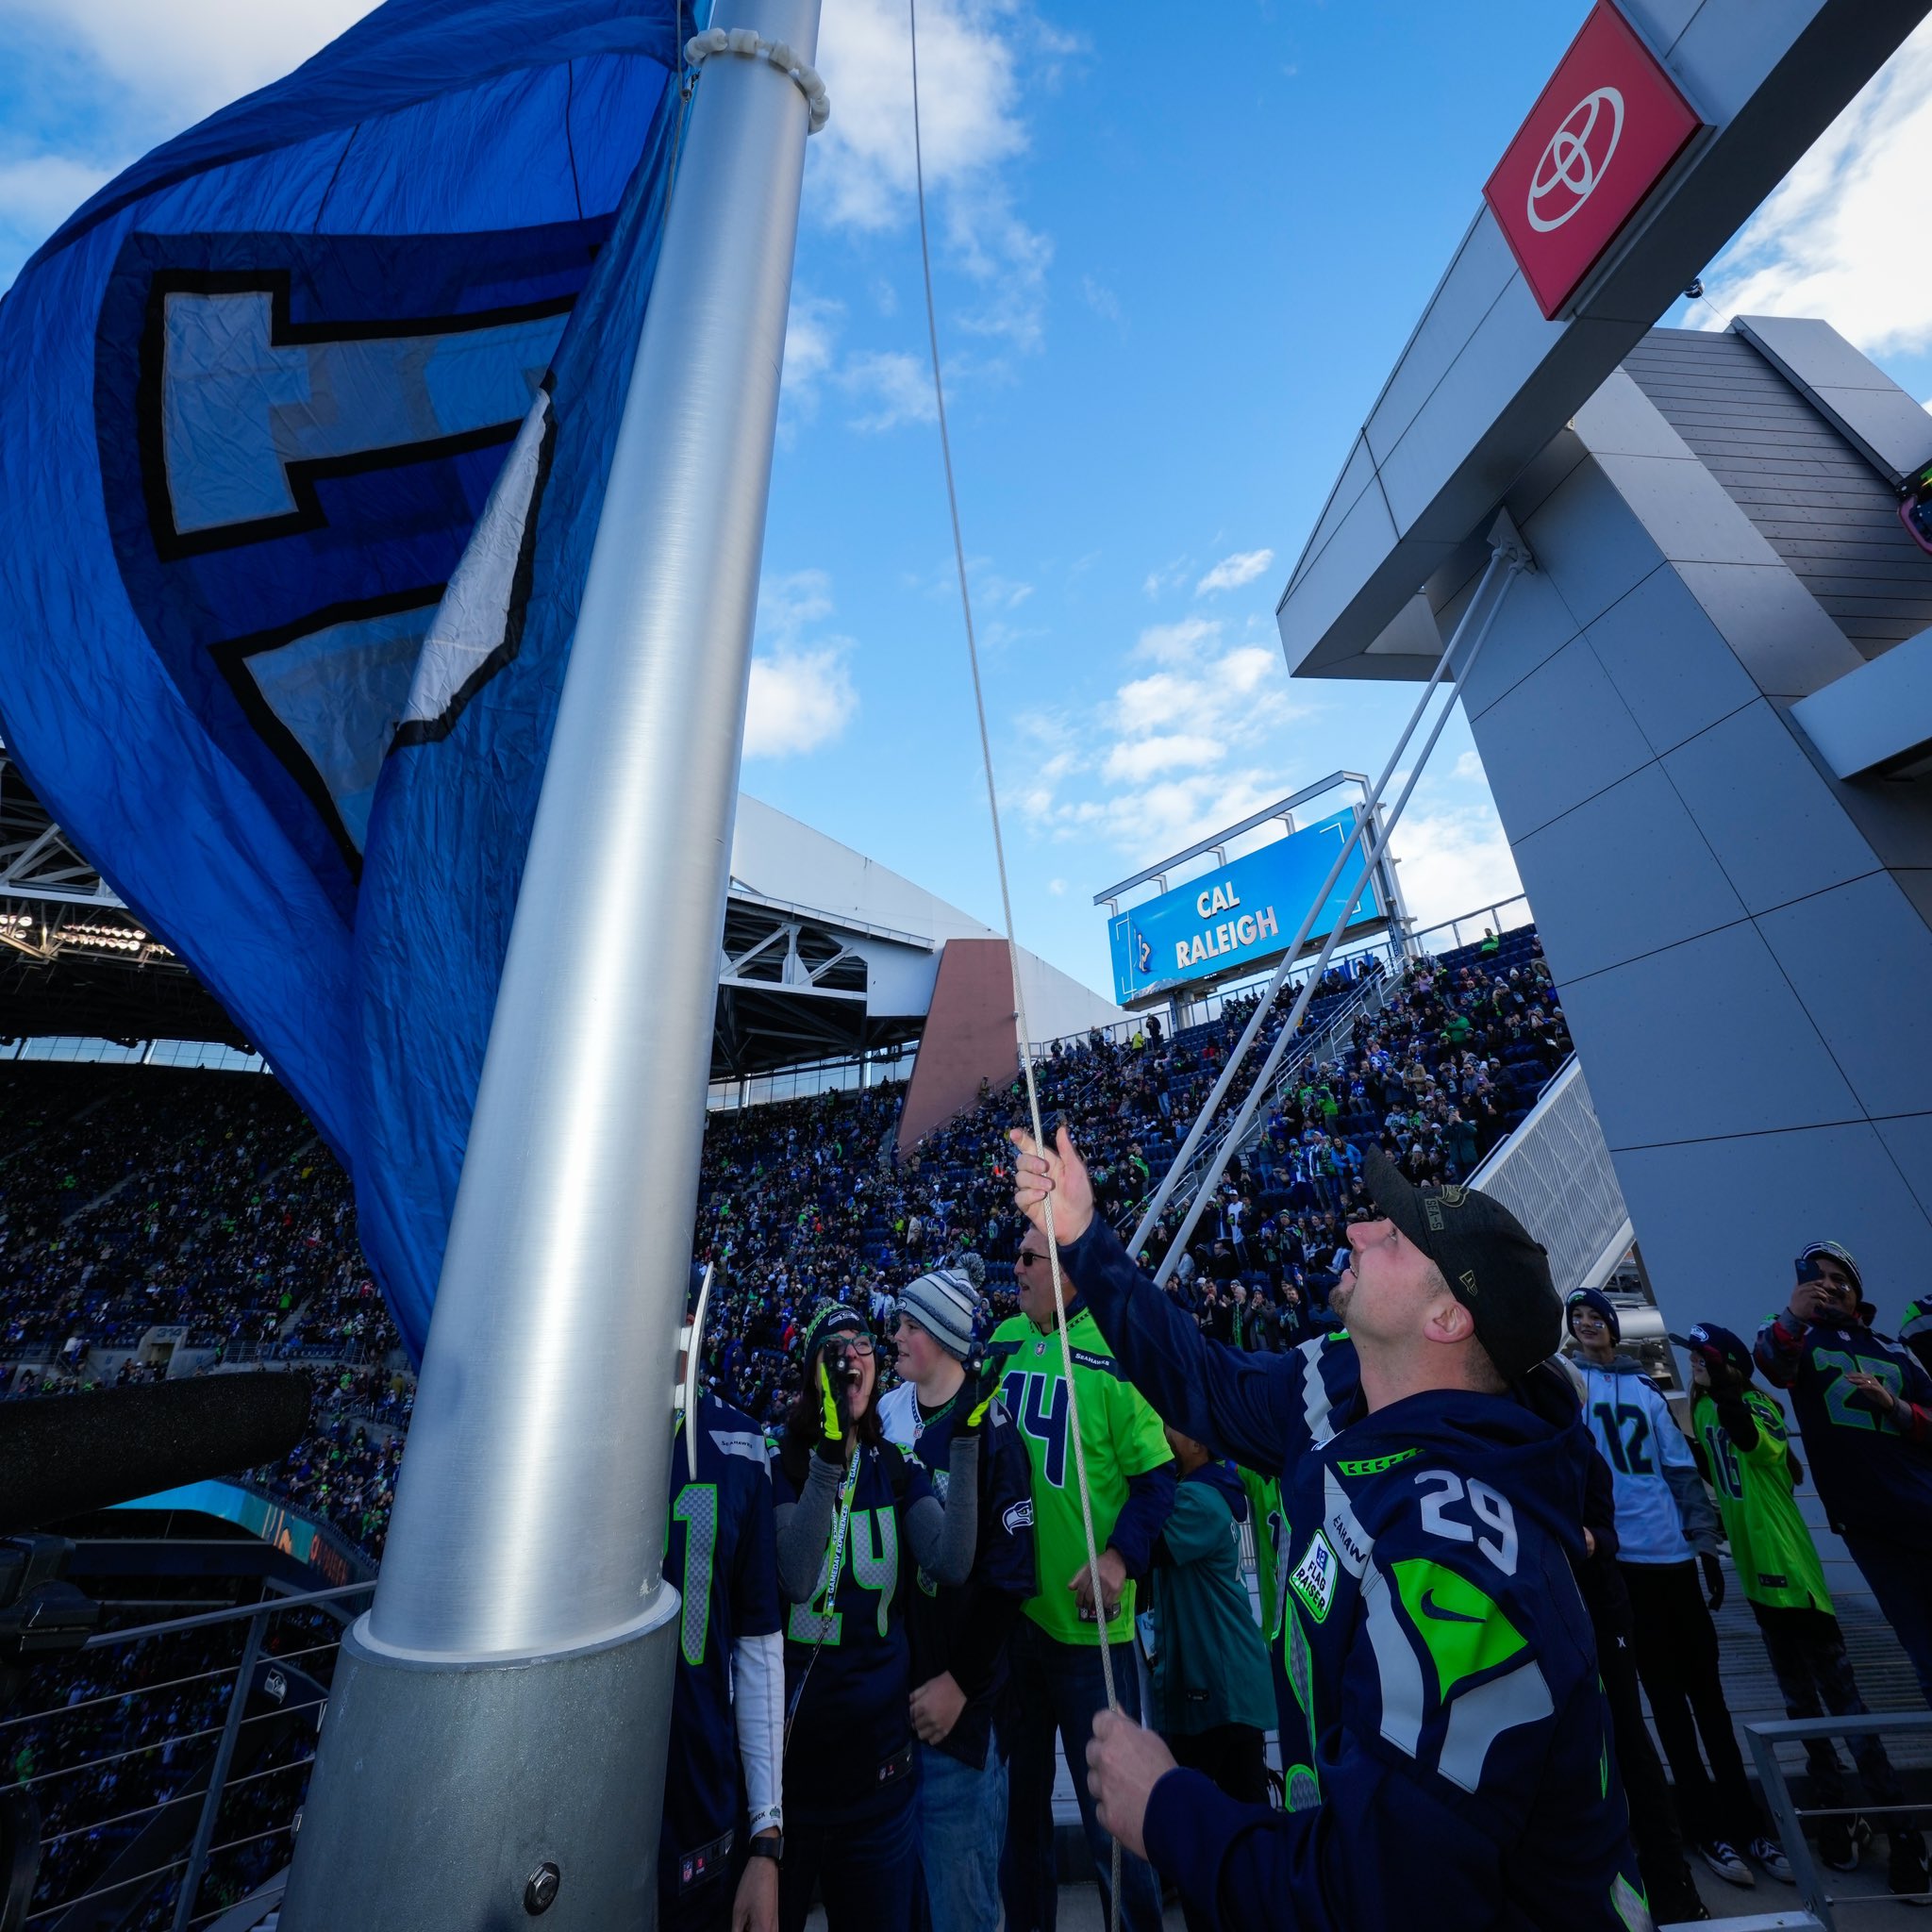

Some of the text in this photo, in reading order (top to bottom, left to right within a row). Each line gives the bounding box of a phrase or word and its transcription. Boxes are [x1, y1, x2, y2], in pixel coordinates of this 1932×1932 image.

[1196, 881, 1241, 919] CAL
[1175, 906, 1279, 970] RALEIGH
[1000, 1371, 1070, 1489] 14
[1592, 1402, 1655, 1475] 12
[828, 1554, 841, 1594] GAMEDAY
[837, 1504, 849, 1554] EXPERIENCES
[1332, 1514, 1367, 1563] EAHAW
[1414, 1470, 1519, 1577] 29
[1296, 1568, 1325, 1612] RAISER
[1307, 1560, 1325, 1591] FLAG
